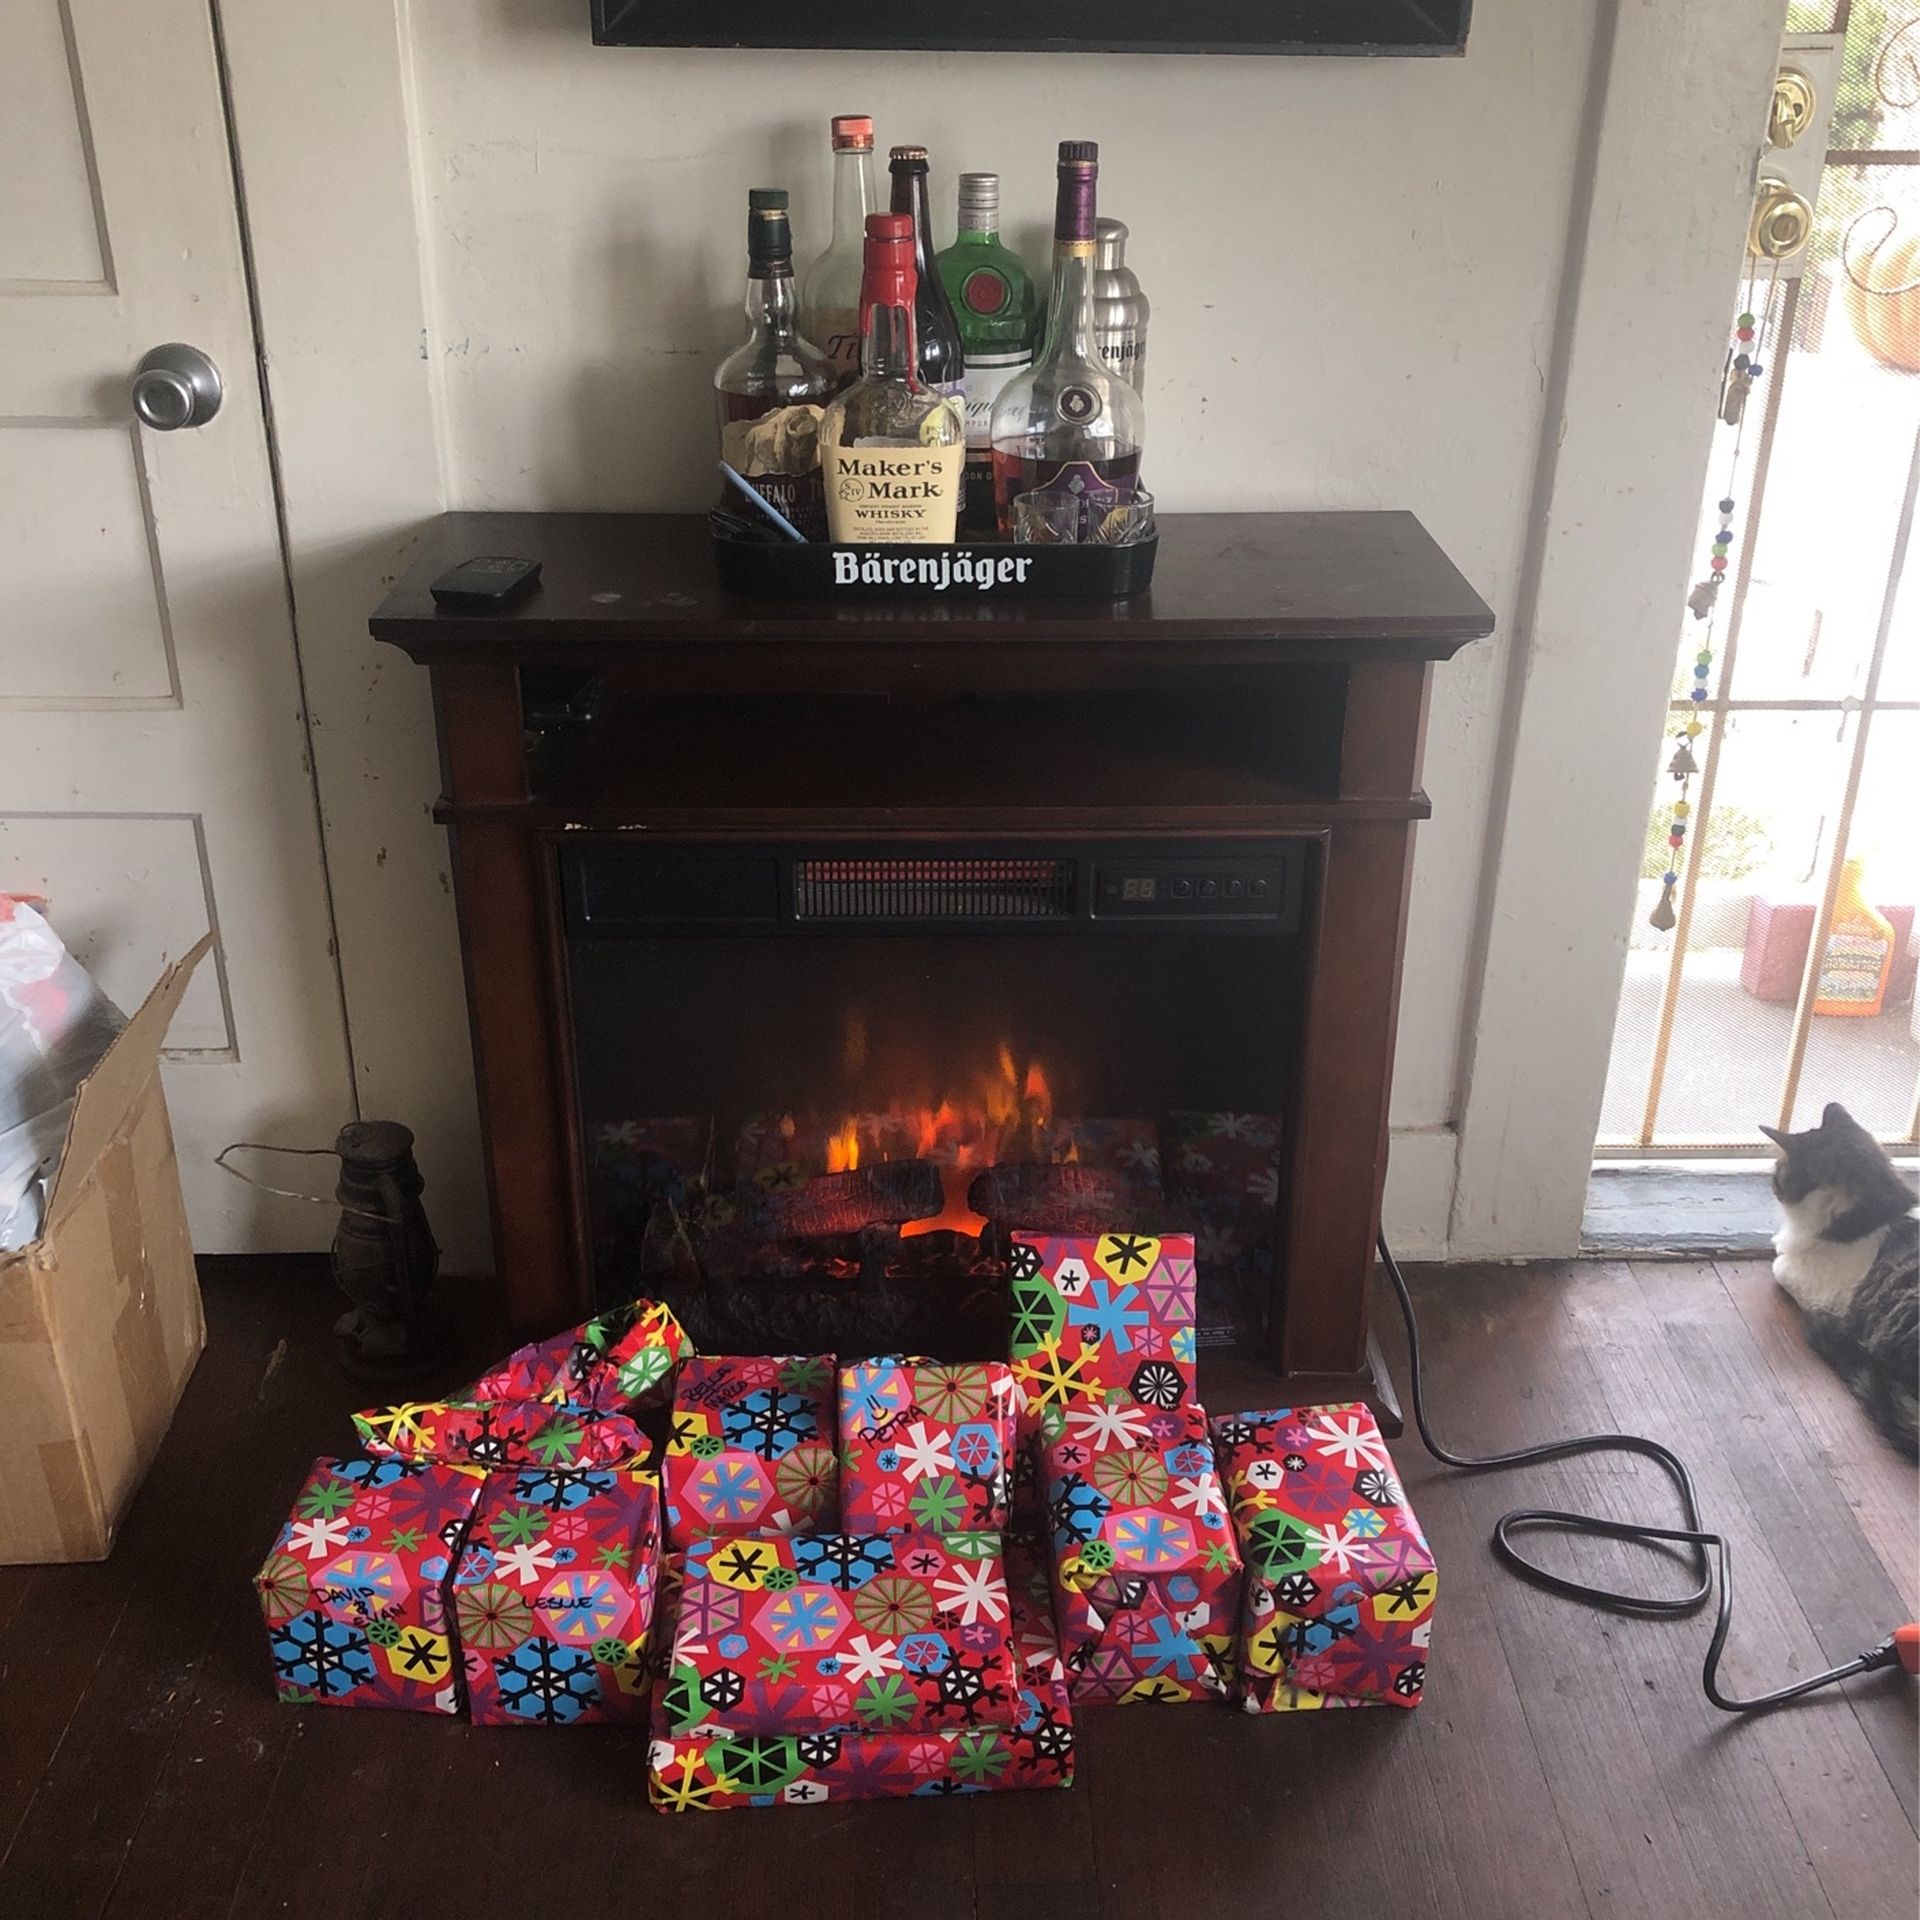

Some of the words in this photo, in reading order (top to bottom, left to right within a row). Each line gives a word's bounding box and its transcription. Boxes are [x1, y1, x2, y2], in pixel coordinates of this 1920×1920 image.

[837, 458, 943, 476] Maker's
[867, 482, 941, 499] Mark
[855, 509, 927, 519] WHISKY
[832, 552, 1033, 591] Bärenjäger
[310, 1587, 375, 1604] DAVID
[521, 1596, 593, 1609] LESLIE
[353, 1603, 407, 1628] EVAN
